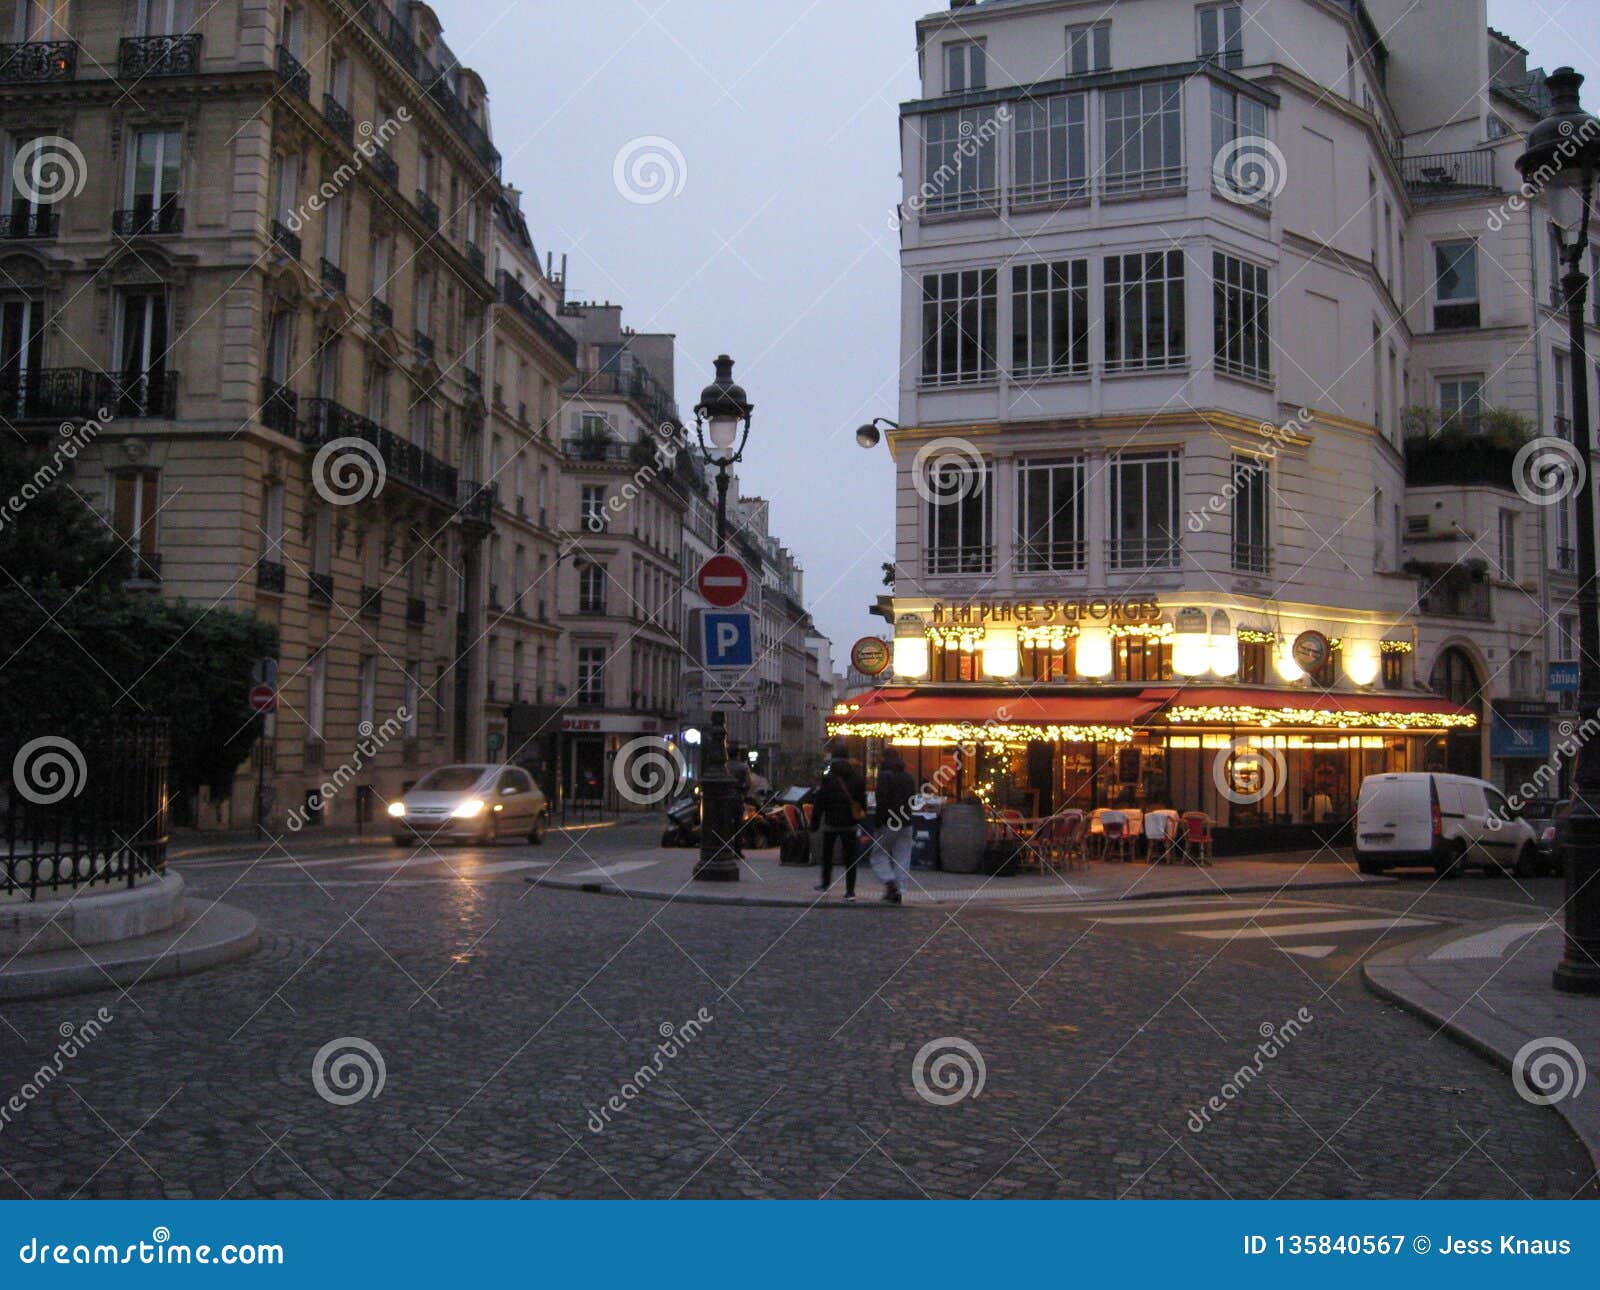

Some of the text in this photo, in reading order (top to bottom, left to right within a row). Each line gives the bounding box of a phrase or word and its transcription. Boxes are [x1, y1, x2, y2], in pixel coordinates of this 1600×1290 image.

[980, 600, 1034, 622] PLACE
[1063, 597, 1161, 621] GEORGES
[717, 622, 739, 657] P
